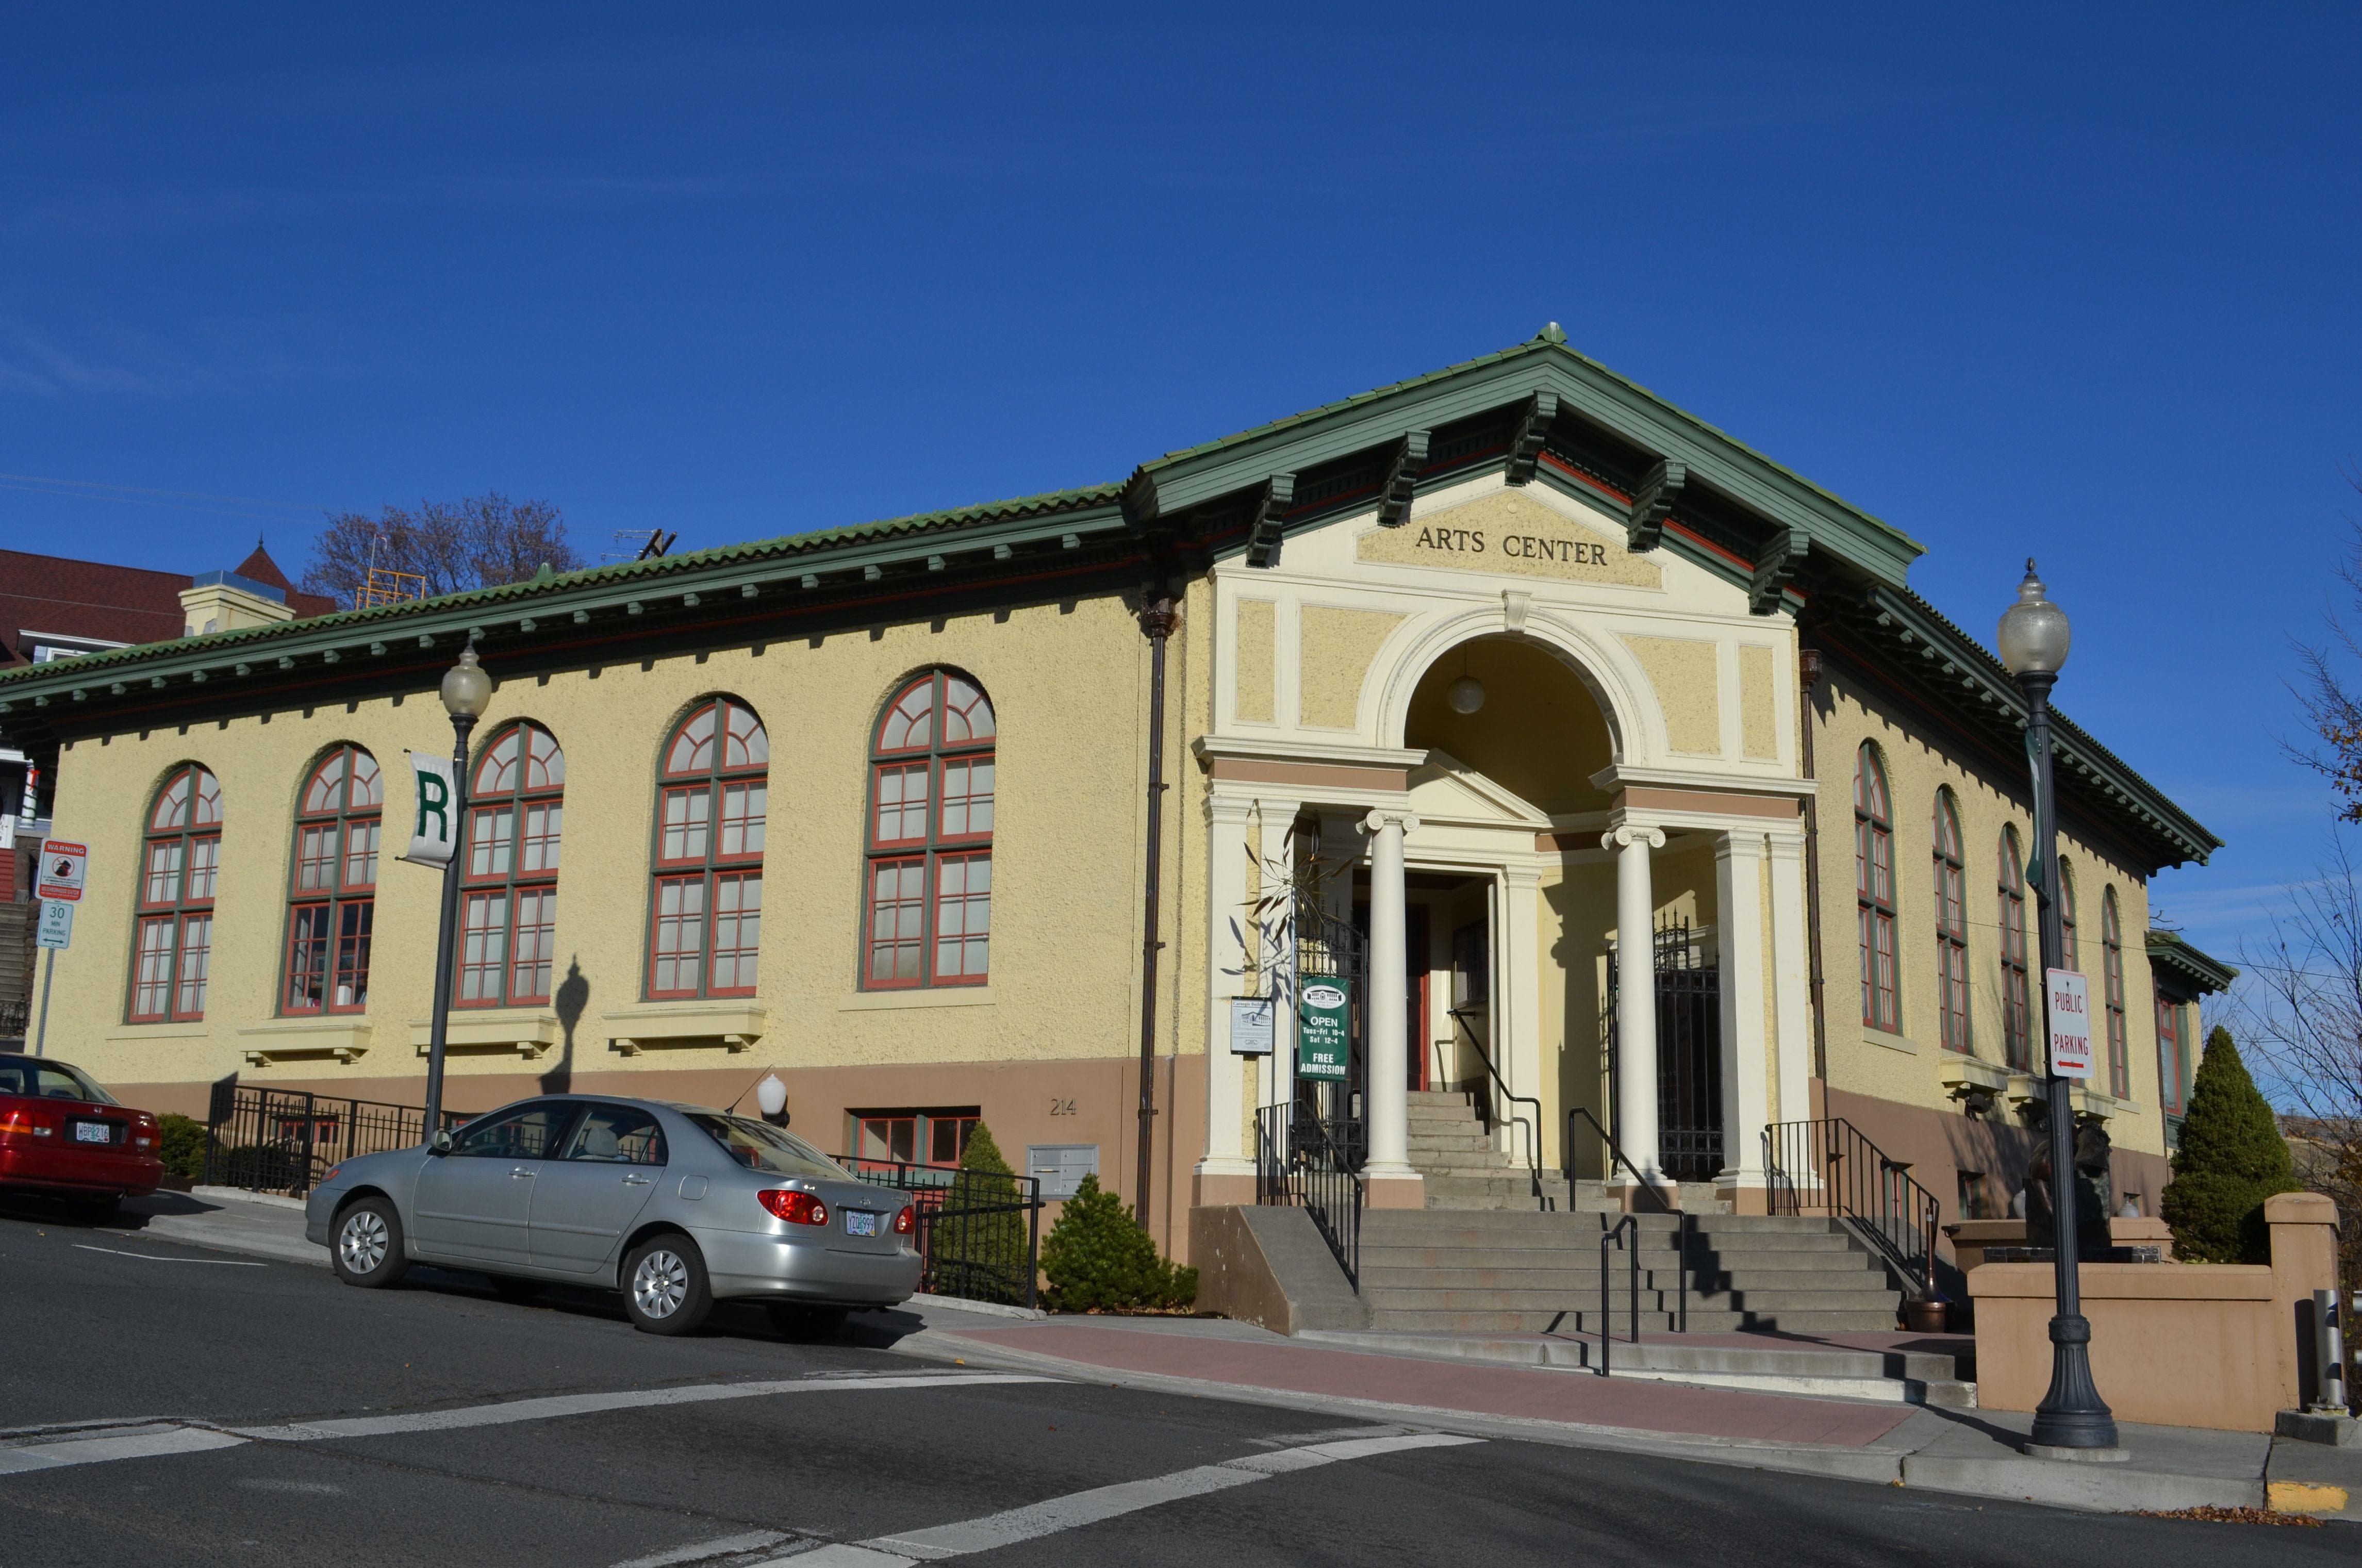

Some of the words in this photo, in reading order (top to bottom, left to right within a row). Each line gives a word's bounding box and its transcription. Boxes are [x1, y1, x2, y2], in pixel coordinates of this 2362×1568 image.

[1416, 526, 1485, 553] ARTS
[1503, 535, 1608, 566] CENTER
[417, 770, 449, 843] R
[47, 844, 84, 854] WARNING
[50, 907, 64, 918] 30
[2055, 992, 2083, 1013] PUBLIC
[1310, 1016, 1337, 1027] OPEN
[2054, 1033, 2088, 1055] PARKING
[1313, 1053, 1334, 1063] FREE
[1300, 1063, 1346, 1075] ADMISSION
[1050, 1099, 1076, 1115] 214
[79, 1126, 91, 1136] WBP
[96, 1127, 108, 1137] 216
[863, 1217, 874, 1230] 999
